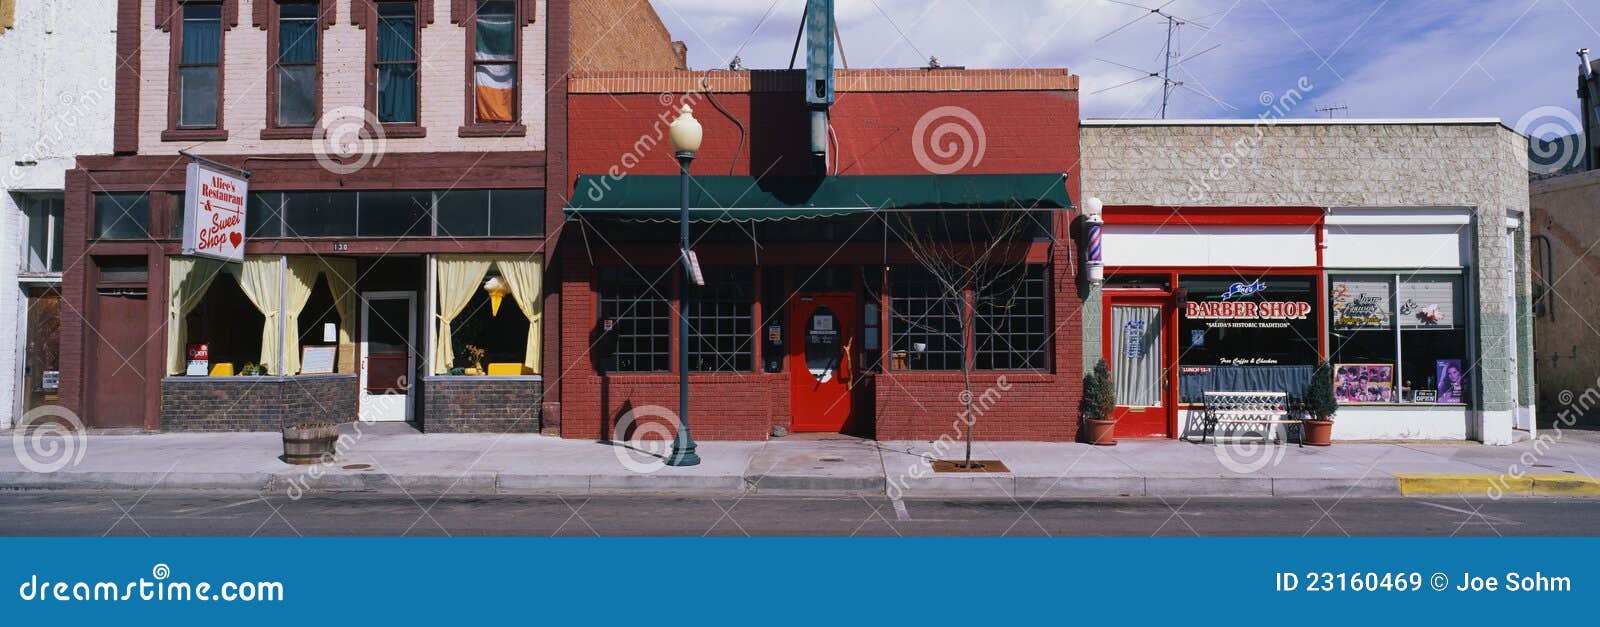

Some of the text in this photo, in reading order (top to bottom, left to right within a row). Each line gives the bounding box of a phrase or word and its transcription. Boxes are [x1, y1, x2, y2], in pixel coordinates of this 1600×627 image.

[212, 175, 236, 192] Alice's
[202, 183, 243, 206] Restaurant
[204, 200, 212, 211] &
[211, 205, 240, 233] Sweet
[198, 228, 227, 253] Shop
[1186, 301, 1311, 319] BARBER SHOP
